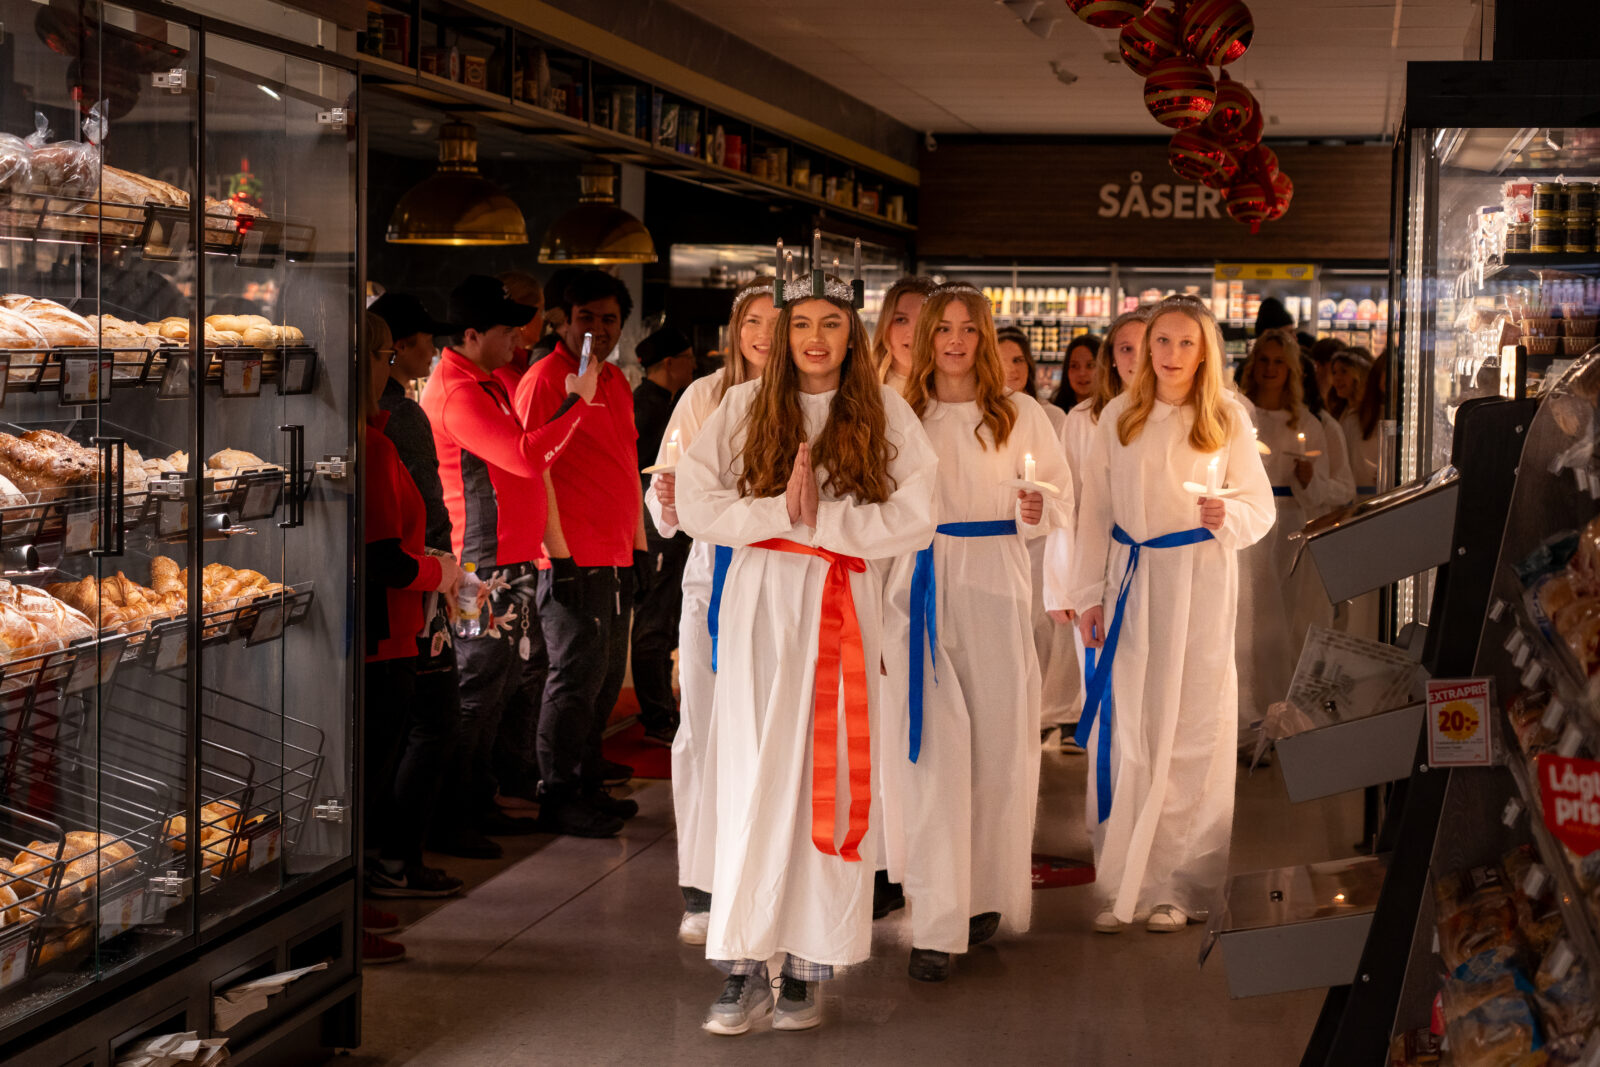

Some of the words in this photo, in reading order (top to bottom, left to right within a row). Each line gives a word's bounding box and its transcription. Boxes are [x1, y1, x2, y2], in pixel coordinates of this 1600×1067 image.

[1098, 170, 1222, 219] SÅSER
[1427, 684, 1489, 704] EXTRAPRIS
[1438, 710, 1480, 732] 20:-
[1555, 797, 1600, 827] pris
